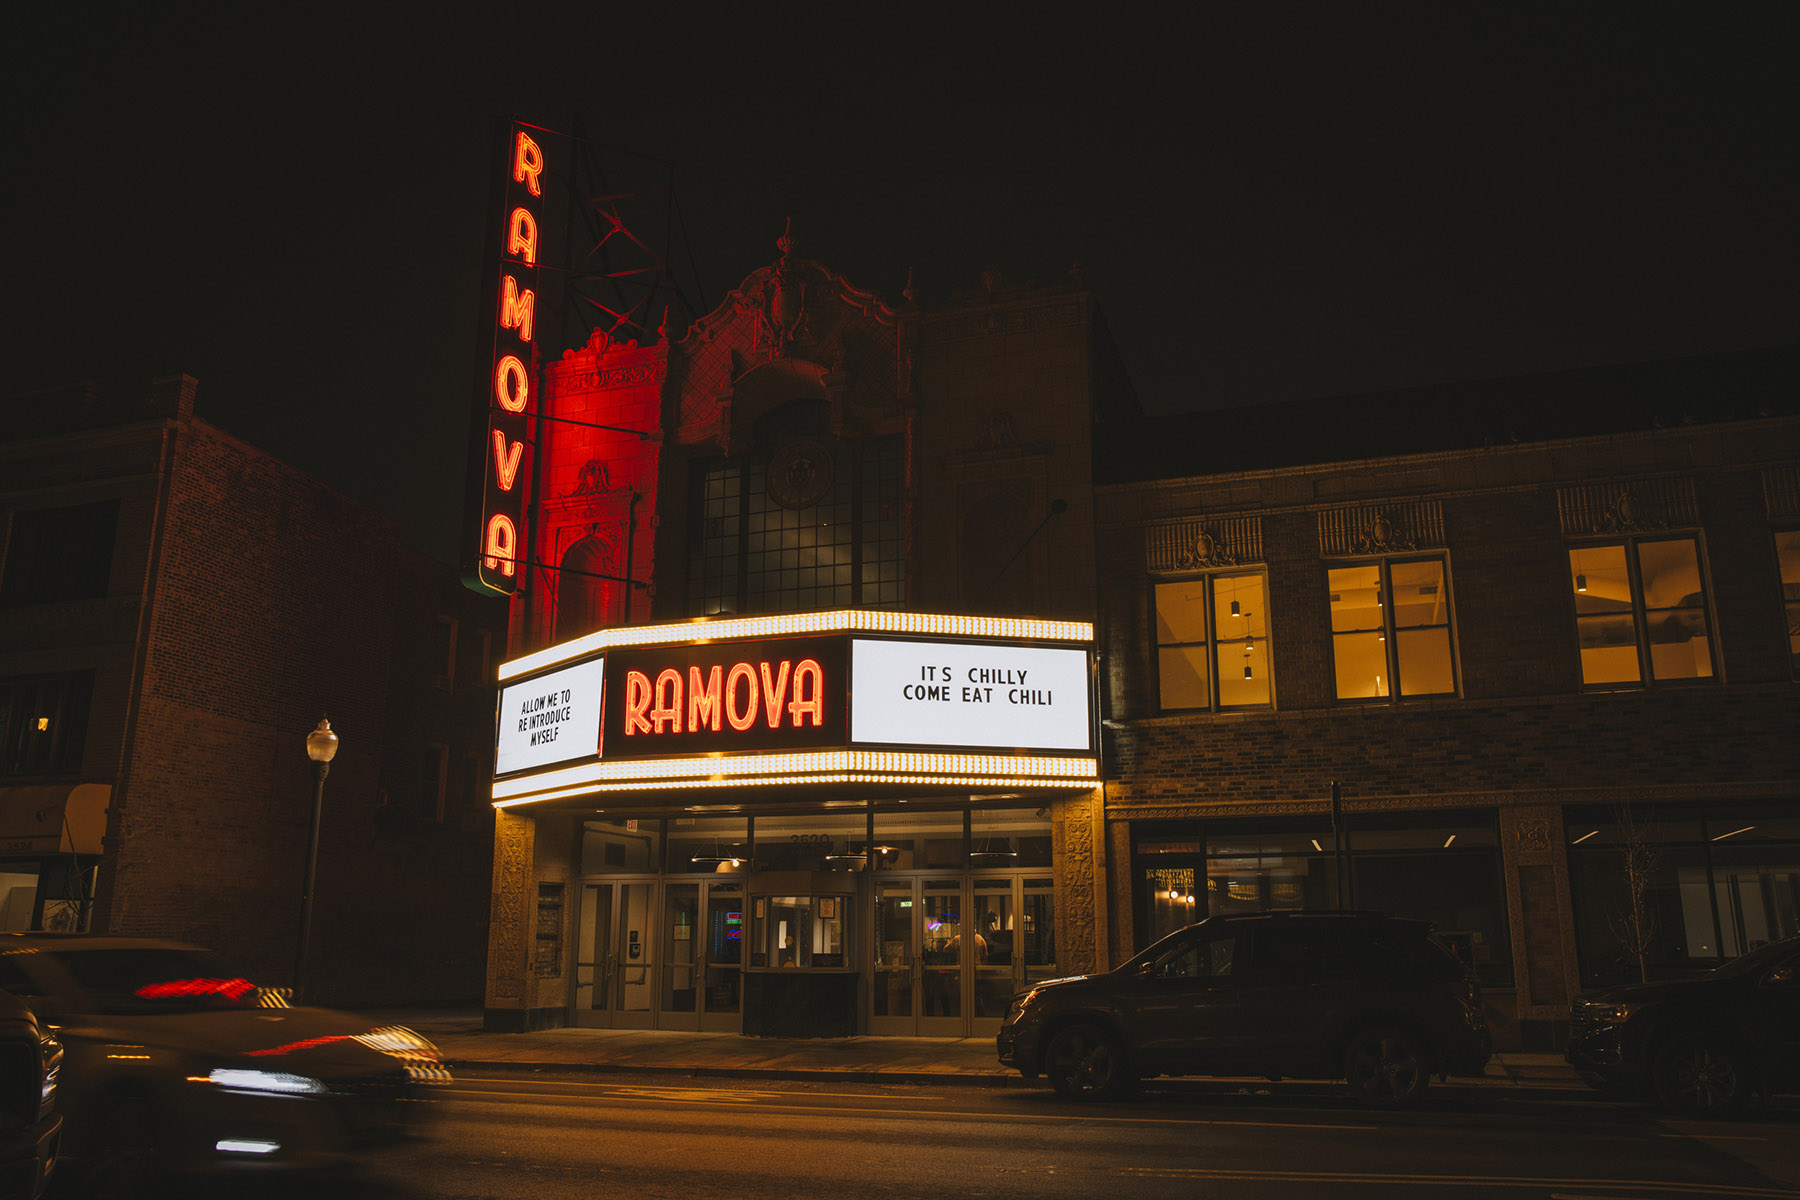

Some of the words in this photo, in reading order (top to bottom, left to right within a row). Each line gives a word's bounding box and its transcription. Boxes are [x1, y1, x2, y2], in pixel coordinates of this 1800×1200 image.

[484, 130, 544, 578] RAMOVA
[967, 667, 1028, 686] CHILLY
[521, 695, 546, 715] ALLOW
[547, 692, 558, 708] ME
[561, 688, 571, 705] TO
[625, 658, 824, 736] RAMOVA
[903, 684, 951, 702] COME
[962, 686, 993, 703] EAT
[1008, 688, 1052, 706] CHILI
[518, 717, 528, 733] RE
[529, 706, 571, 730] INTRODUCE
[530, 726, 559, 747] MYSELF
